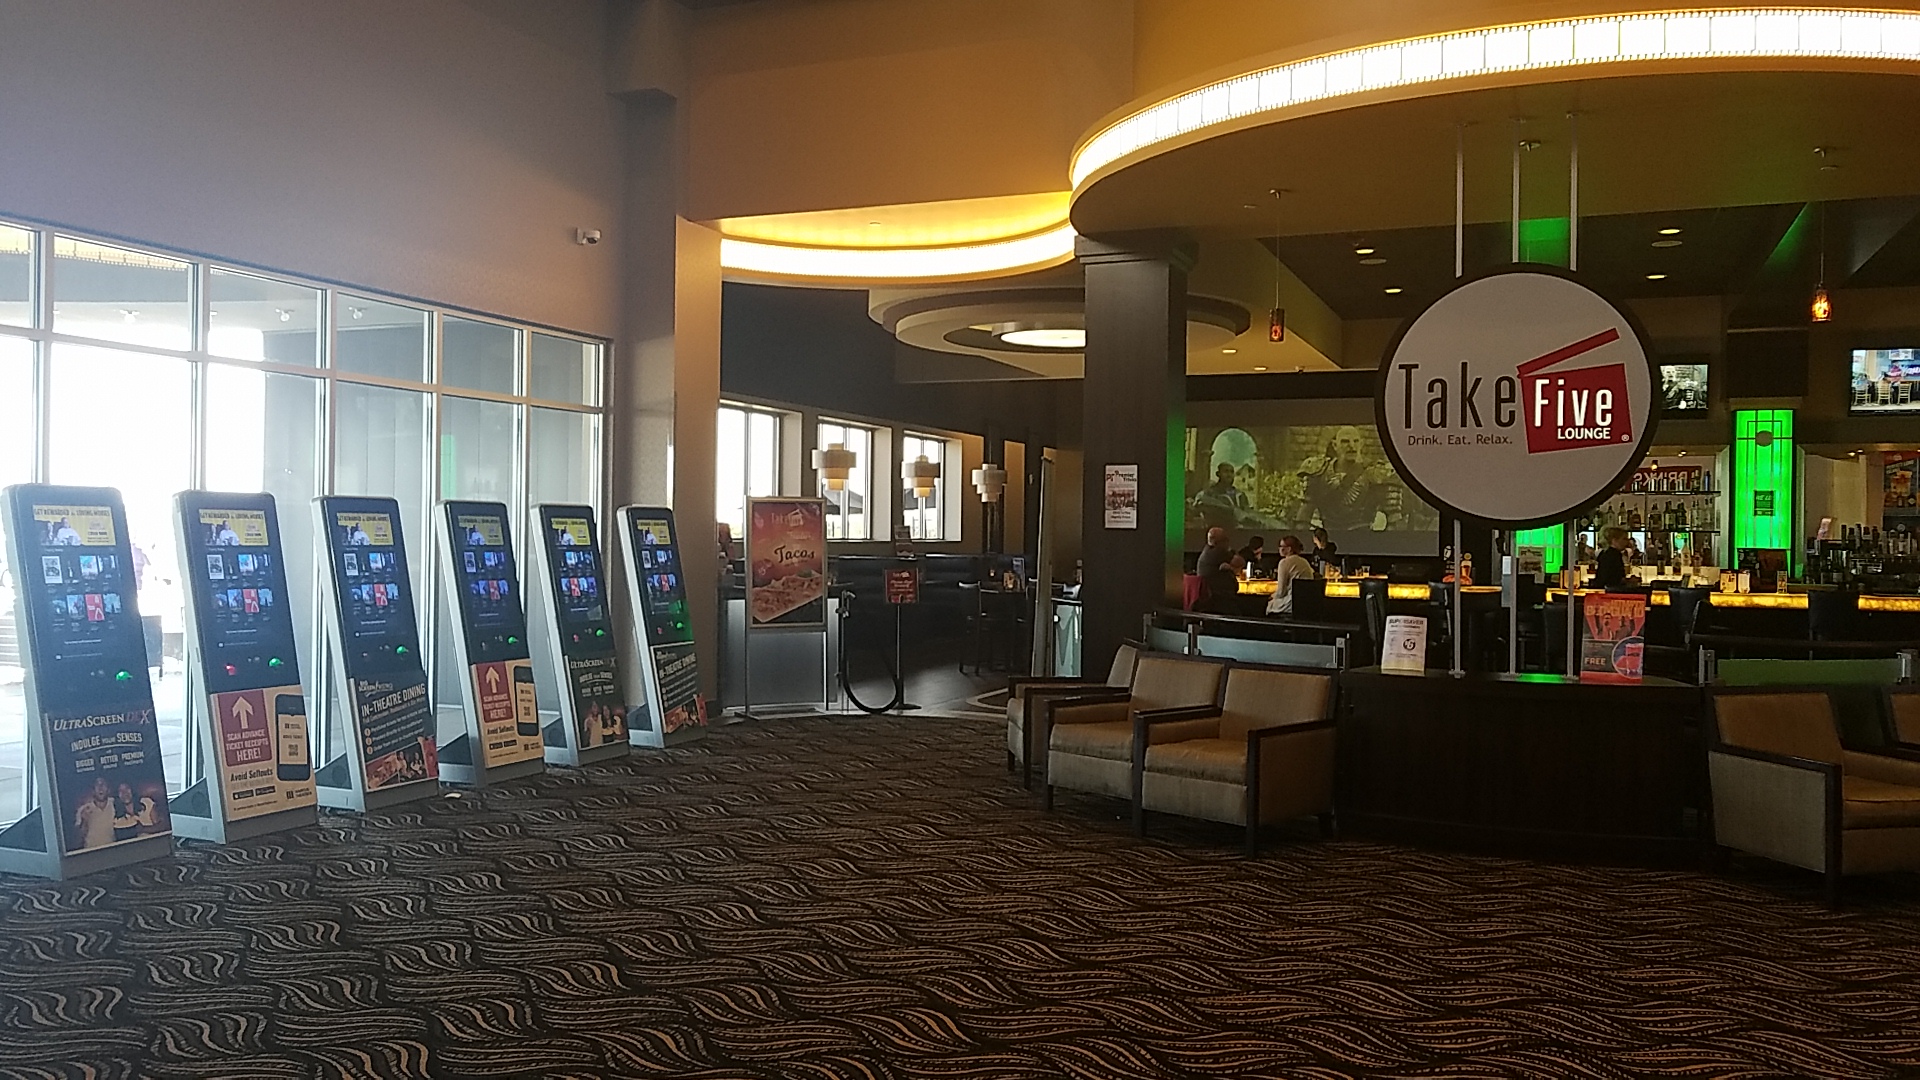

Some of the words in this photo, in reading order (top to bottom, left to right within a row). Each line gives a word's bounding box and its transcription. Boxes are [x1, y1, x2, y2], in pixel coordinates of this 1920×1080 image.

[1398, 361, 1516, 429] Take
[1534, 378, 1613, 428] Five
[1407, 435, 1443, 446] Drink.
[1447, 435, 1471, 445] Eat.
[1476, 434, 1513, 445] Relax.
[1557, 428, 1611, 440] LOUNGE
[774, 545, 815, 563] Tacos
[1584, 657, 1606, 666] FREE
[361, 691, 402, 717] IN-THEATRE
[402, 683, 426, 702] DINING
[71, 735, 101, 752] INDULGE
[116, 732, 143, 743] SENSES
[227, 730, 242, 742] SCAN
[242, 728, 266, 740] ADVANCE
[226, 741, 245, 752] TICKET
[245, 737, 269, 749] RECEIPTS
[100, 754, 119, 764] BETTER
[236, 747, 262, 762] HERE!
[230, 770, 248, 782] Avoid
[248, 767, 274, 780] Sellouts
